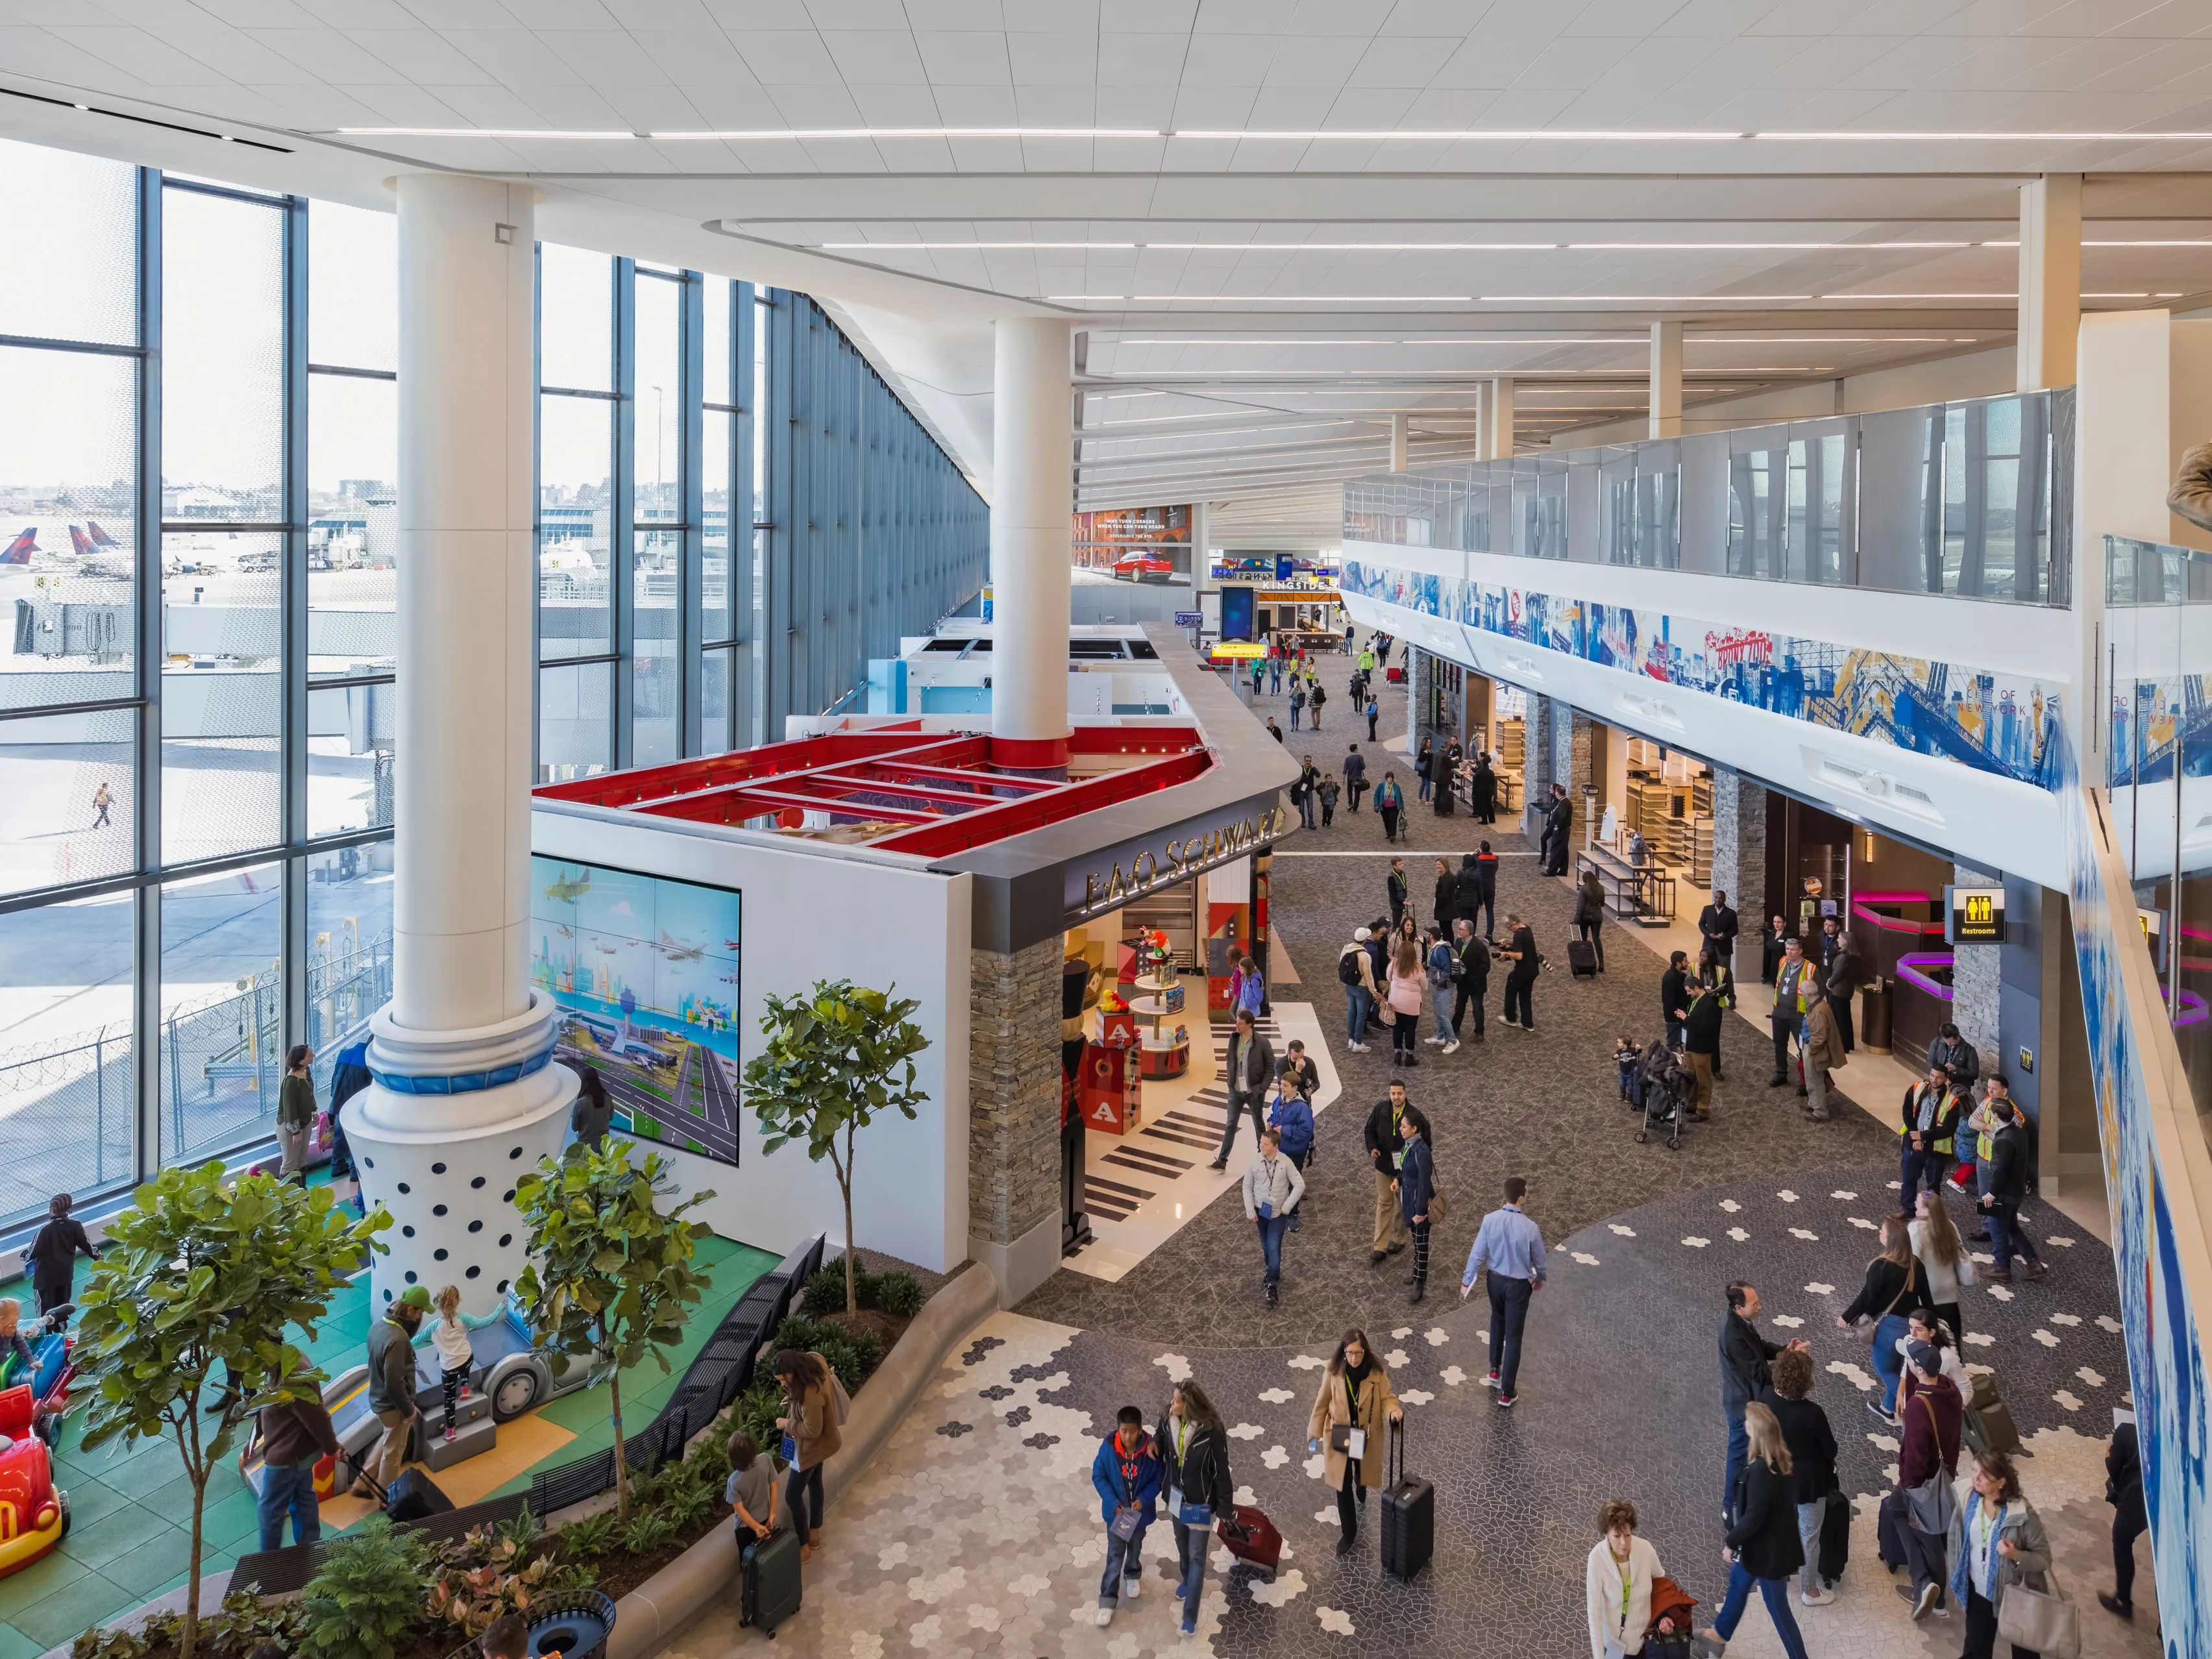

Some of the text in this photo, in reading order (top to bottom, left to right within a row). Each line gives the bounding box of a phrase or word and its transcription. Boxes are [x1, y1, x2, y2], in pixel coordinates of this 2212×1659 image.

[38, 577, 44, 588] 49
[1262, 582, 1325, 590] KINGSIDE
[1718, 645, 1744, 670] BRONX
[2000, 690, 2015, 700] OF
[1811, 701, 1822, 717] THE
[1815, 696, 1841, 720] UPTOWN
[1958, 703, 2026, 715] NEW YORK
[1108, 1024, 1130, 1040] A
[1092, 1101, 1118, 1124] A
